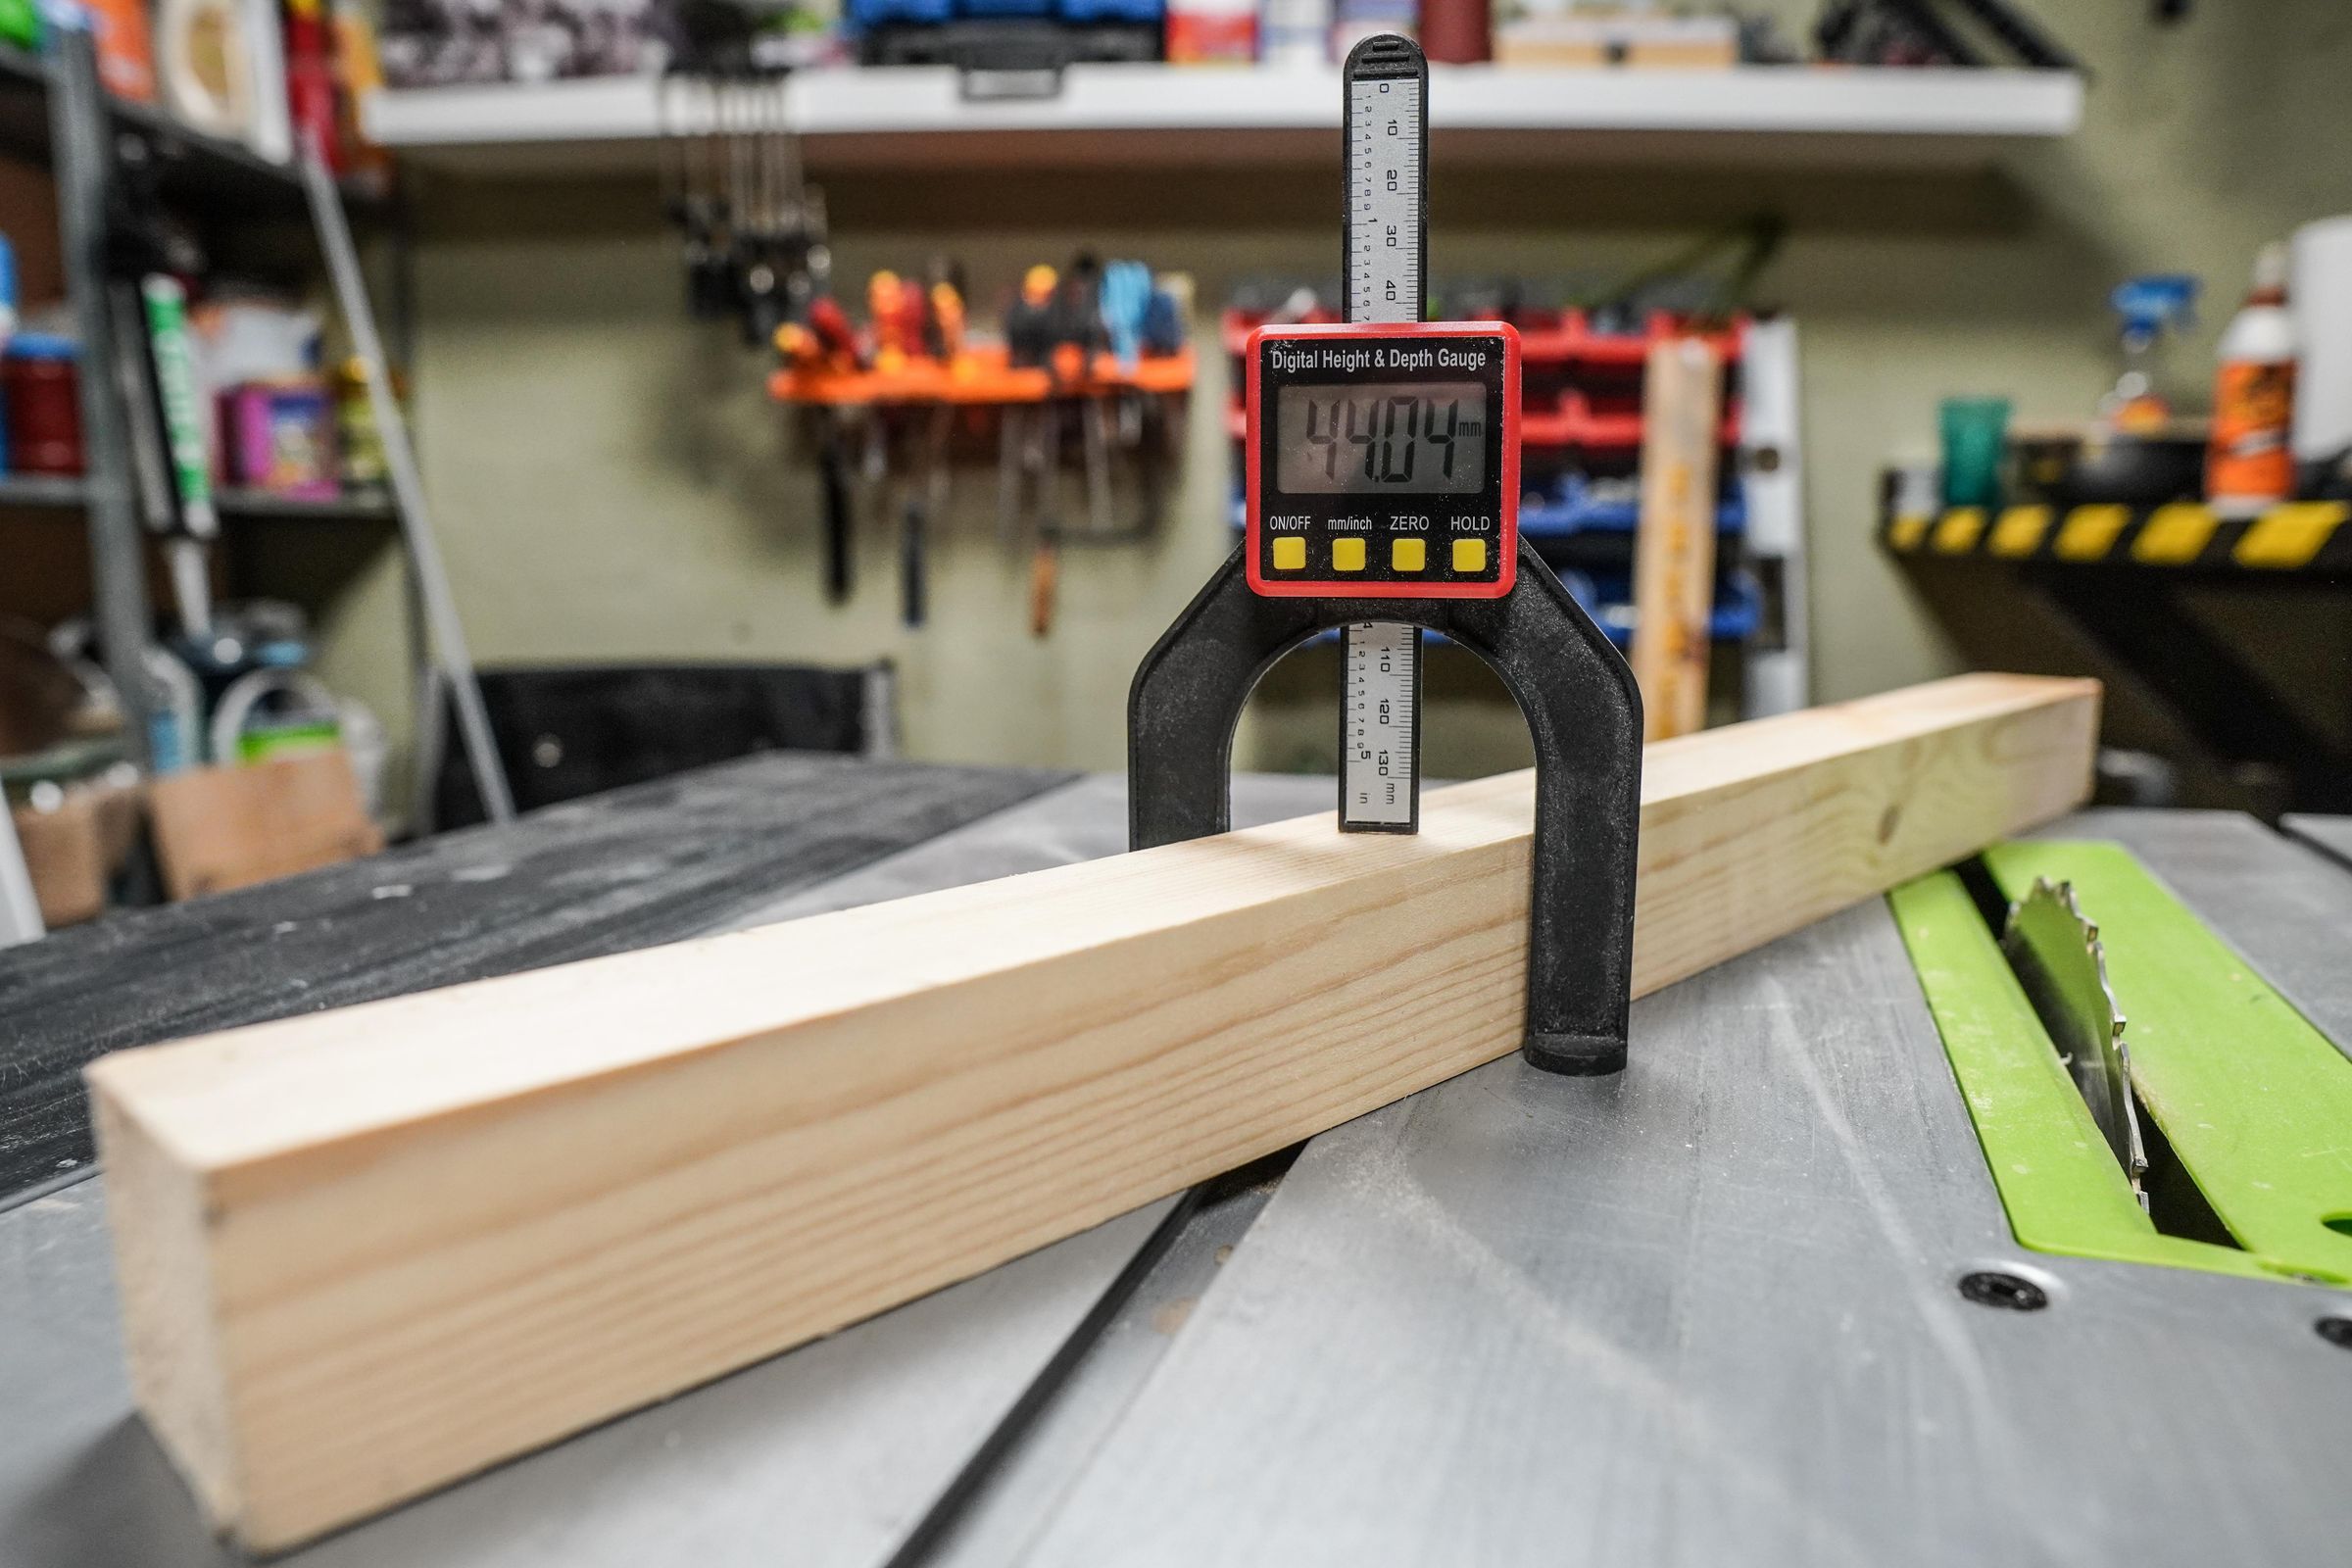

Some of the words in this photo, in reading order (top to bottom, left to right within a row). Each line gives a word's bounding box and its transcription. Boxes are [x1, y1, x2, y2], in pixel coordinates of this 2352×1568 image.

[1380, 83, 1390, 93] 0
[1388, 120, 1397, 136] 10
[1387, 170, 1397, 191] 20
[1387, 225, 1396, 247] 30
[1386, 280, 1396, 301] 40
[1272, 350, 1318, 373] Digital
[1323, 349, 1370, 371] Height
[1374, 349, 1386, 368] &
[1390, 349, 1433, 371] Depth
[1438, 348, 1486, 371] Gauge
[1306, 395, 1458, 483] 44.04
[1458, 421, 1482, 437] mm
[1269, 515, 1311, 530] ON/OFF
[1328, 515, 1373, 531] mm/inch
[1390, 515, 1430, 530] ZERO
[1450, 515, 1491, 530] HOLD
[1381, 647, 1391, 672] 110
[1380, 698, 1390, 725] 120
[1361, 751, 1371, 760] 5
[1379, 749, 1389, 776] 130
[1359, 792, 1371, 804] in
[1386, 782, 1395, 805] mm
